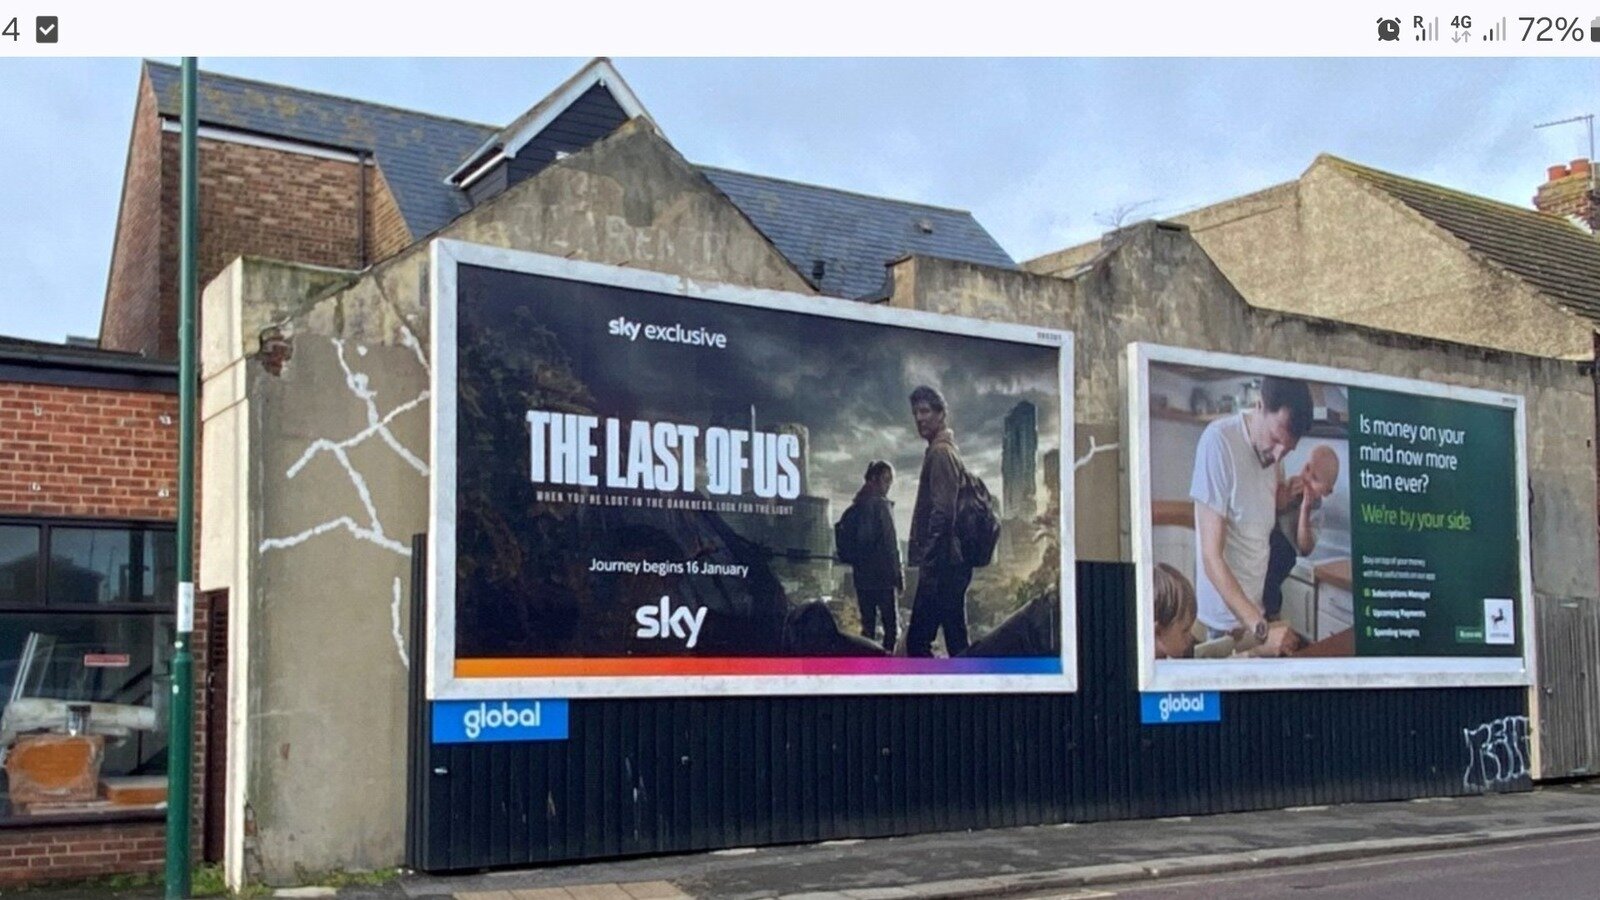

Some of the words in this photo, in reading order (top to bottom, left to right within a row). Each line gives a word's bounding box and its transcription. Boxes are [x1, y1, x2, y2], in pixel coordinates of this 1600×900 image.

[608, 316, 642, 342] sky
[644, 323, 727, 349] exclusive
[1360, 414, 1370, 434] Is
[1373, 419, 1417, 444] money
[1419, 425, 1436, 442] on
[1438, 429, 1466, 447] your
[526, 410, 599, 486] THE
[606, 417, 699, 493] LAST
[706, 427, 749, 496] OF
[752, 432, 801, 500] US
[1360, 442, 1394, 463] mind
[1396, 449, 1423, 467] now
[1425, 452, 1458, 470] more
[1360, 468, 1392, 490] than
[1394, 474, 1430, 494] ever?
[537, 490, 563, 502] WHEN
[605, 495, 629, 506] LOST
[646, 497, 663, 508] THE
[1361, 503, 1398, 525] We're
[1400, 505, 1414, 530] by
[1417, 512, 1444, 532] your
[1447, 510, 1472, 531] side
[589, 558, 641, 575] Journey
[643, 559, 684, 577] begins
[686, 561, 699, 574] 16
[701, 561, 749, 578] January
[635, 595, 708, 648] sky
[463, 701, 541, 739] global
[1159, 693, 1204, 721] global
